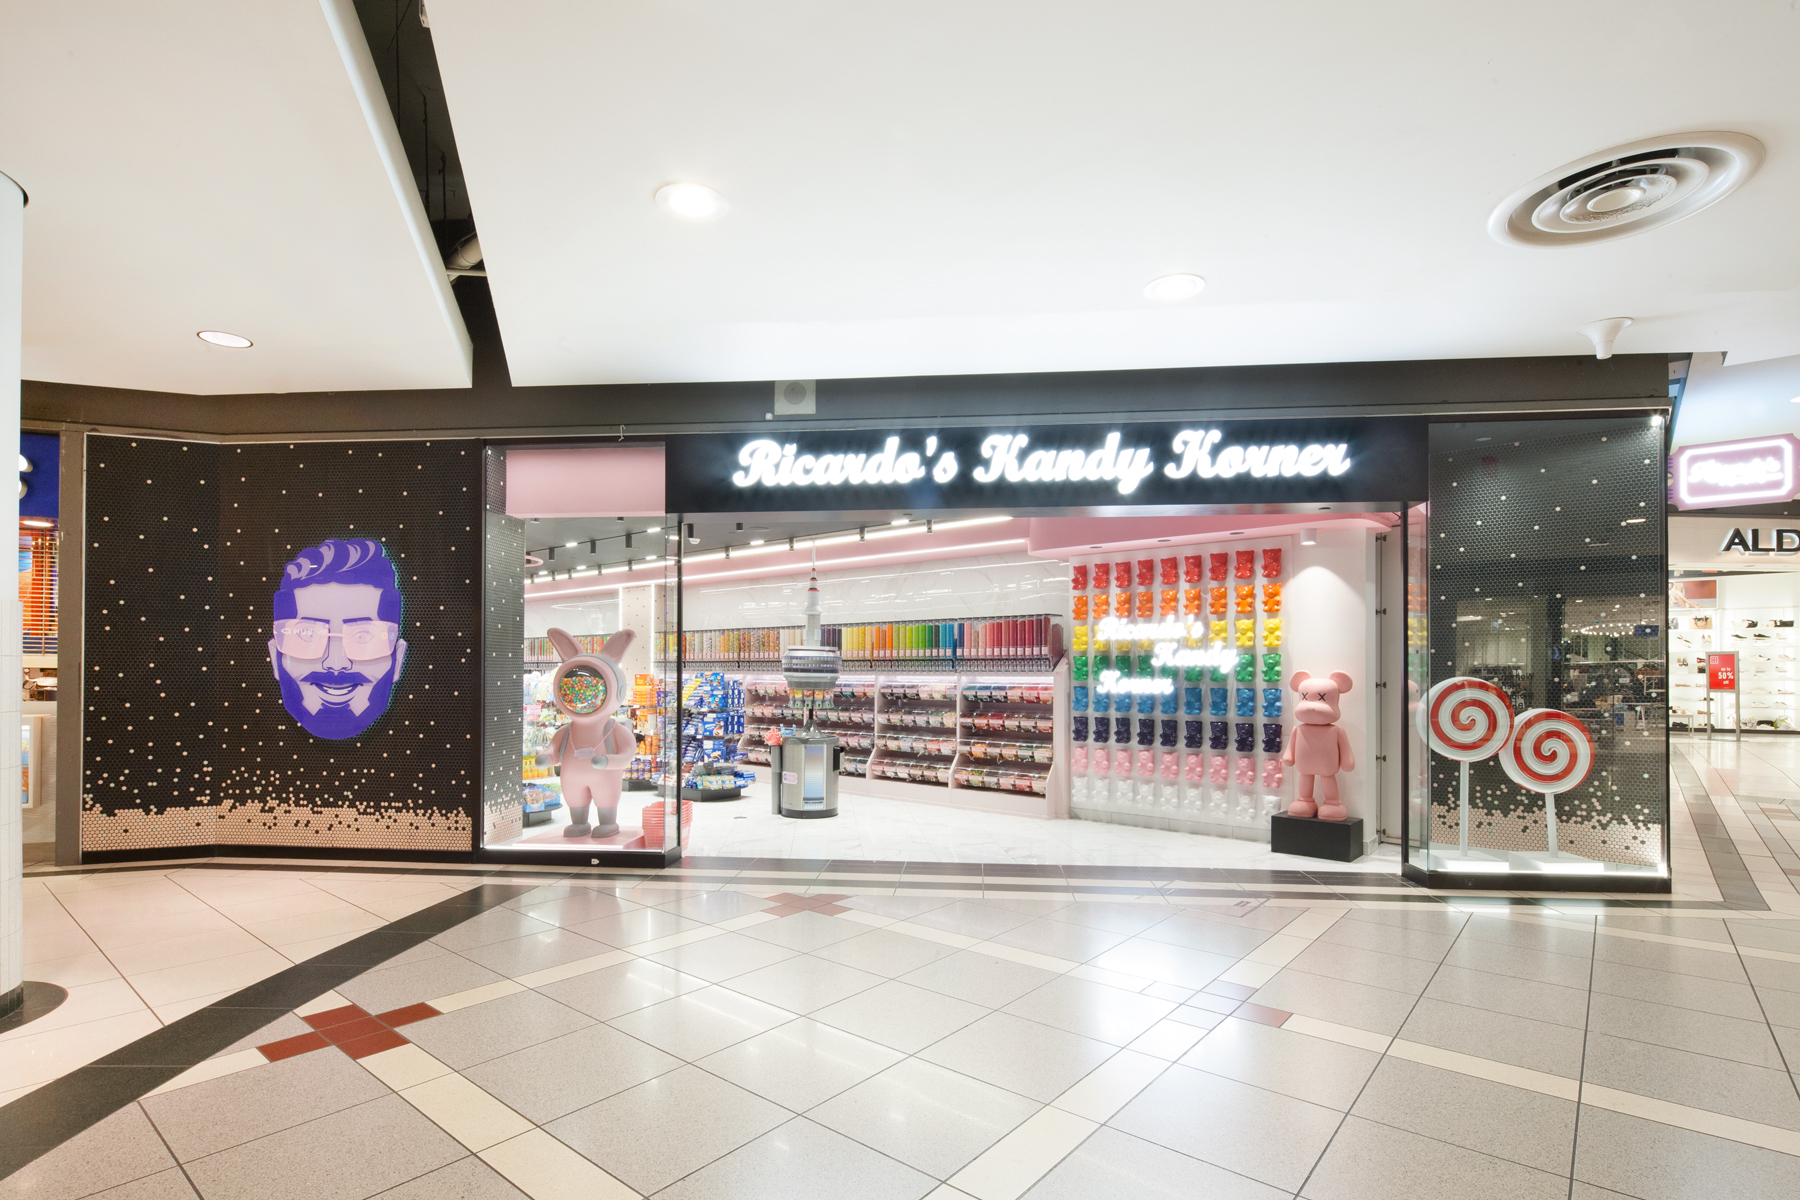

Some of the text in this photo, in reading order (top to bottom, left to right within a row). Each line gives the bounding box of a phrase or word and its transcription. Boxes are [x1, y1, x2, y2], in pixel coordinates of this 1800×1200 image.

[732, 429, 1351, 495] Ricardo's Kandy Korner
[1721, 527, 1800, 552] ALD
[1096, 613, 1205, 641] Ricardo's
[1151, 640, 1240, 674] Kandy
[1718, 671, 1734, 679] 50%
